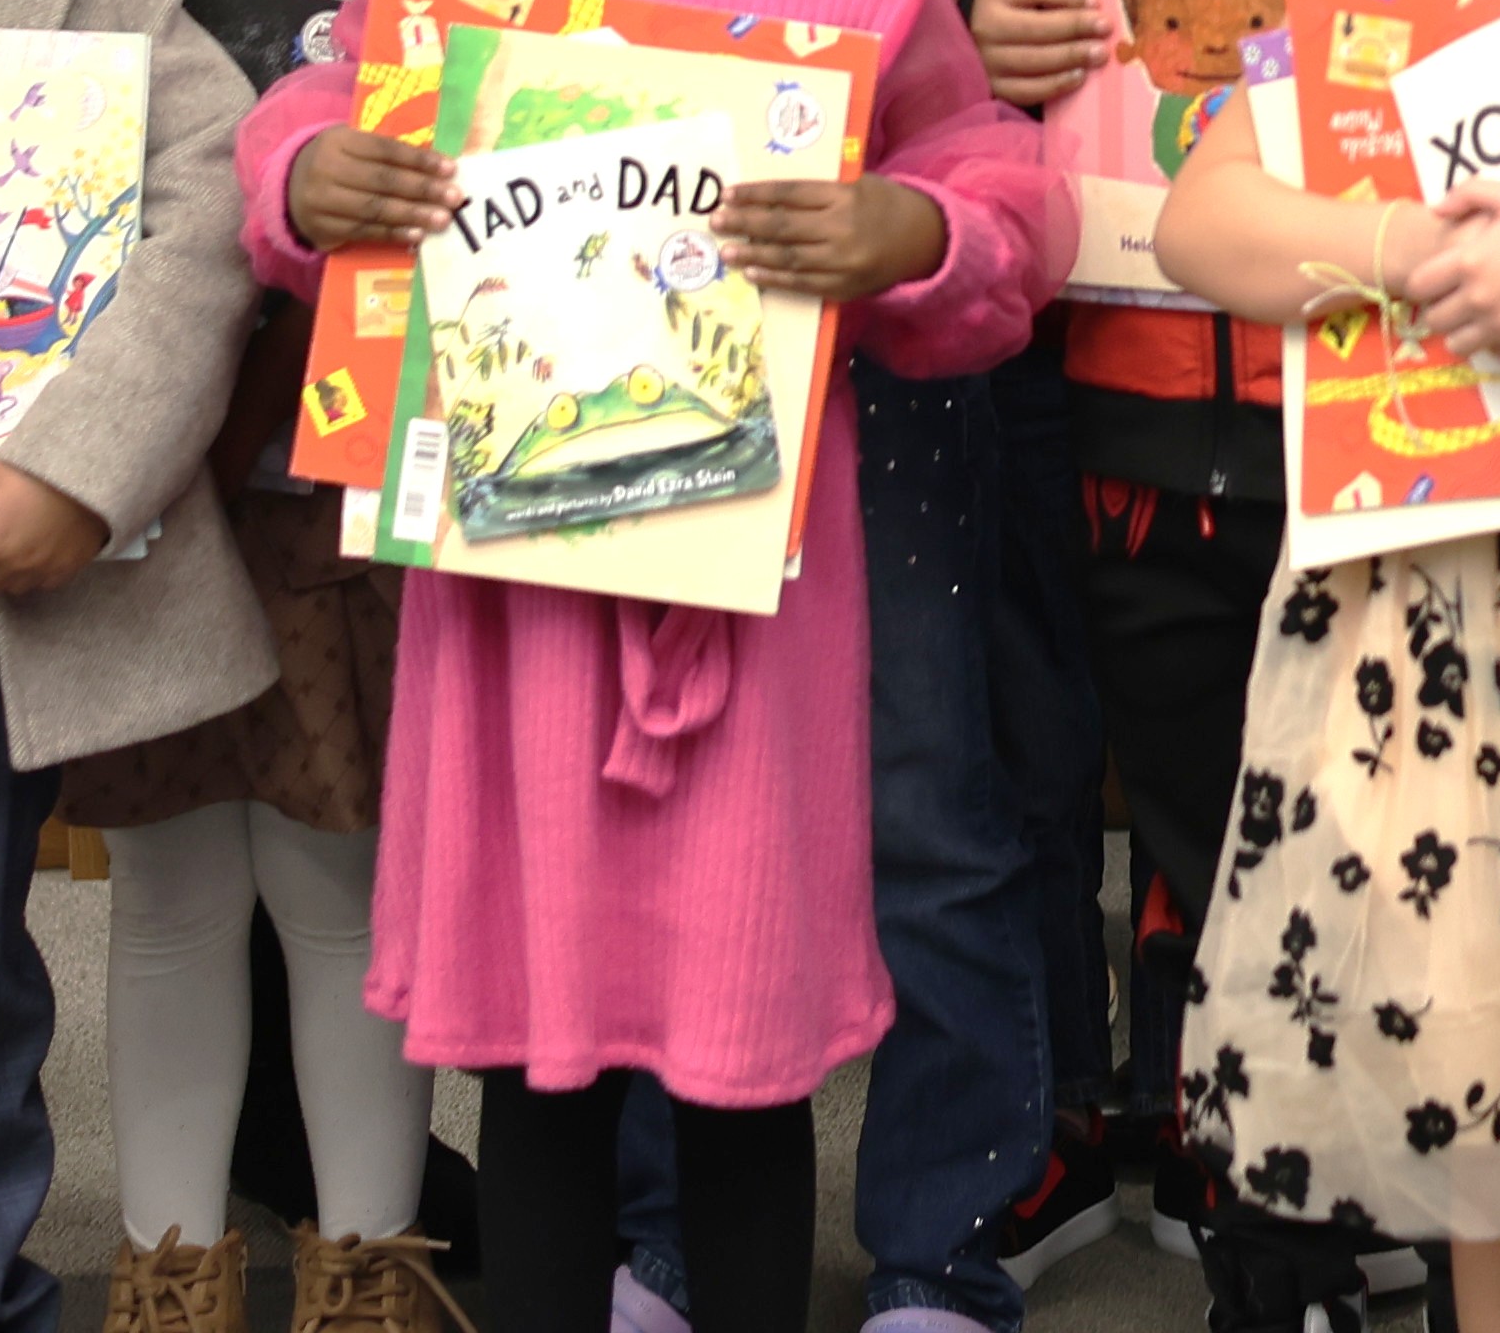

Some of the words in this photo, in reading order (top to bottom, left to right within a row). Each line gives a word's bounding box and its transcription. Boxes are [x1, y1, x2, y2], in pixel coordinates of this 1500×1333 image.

[450, 176, 545, 254] TAD
[556, 172, 604, 204] and
[617, 156, 725, 217] DAD
[612, 481, 655, 502] David
[695, 467, 736, 488] Stein
